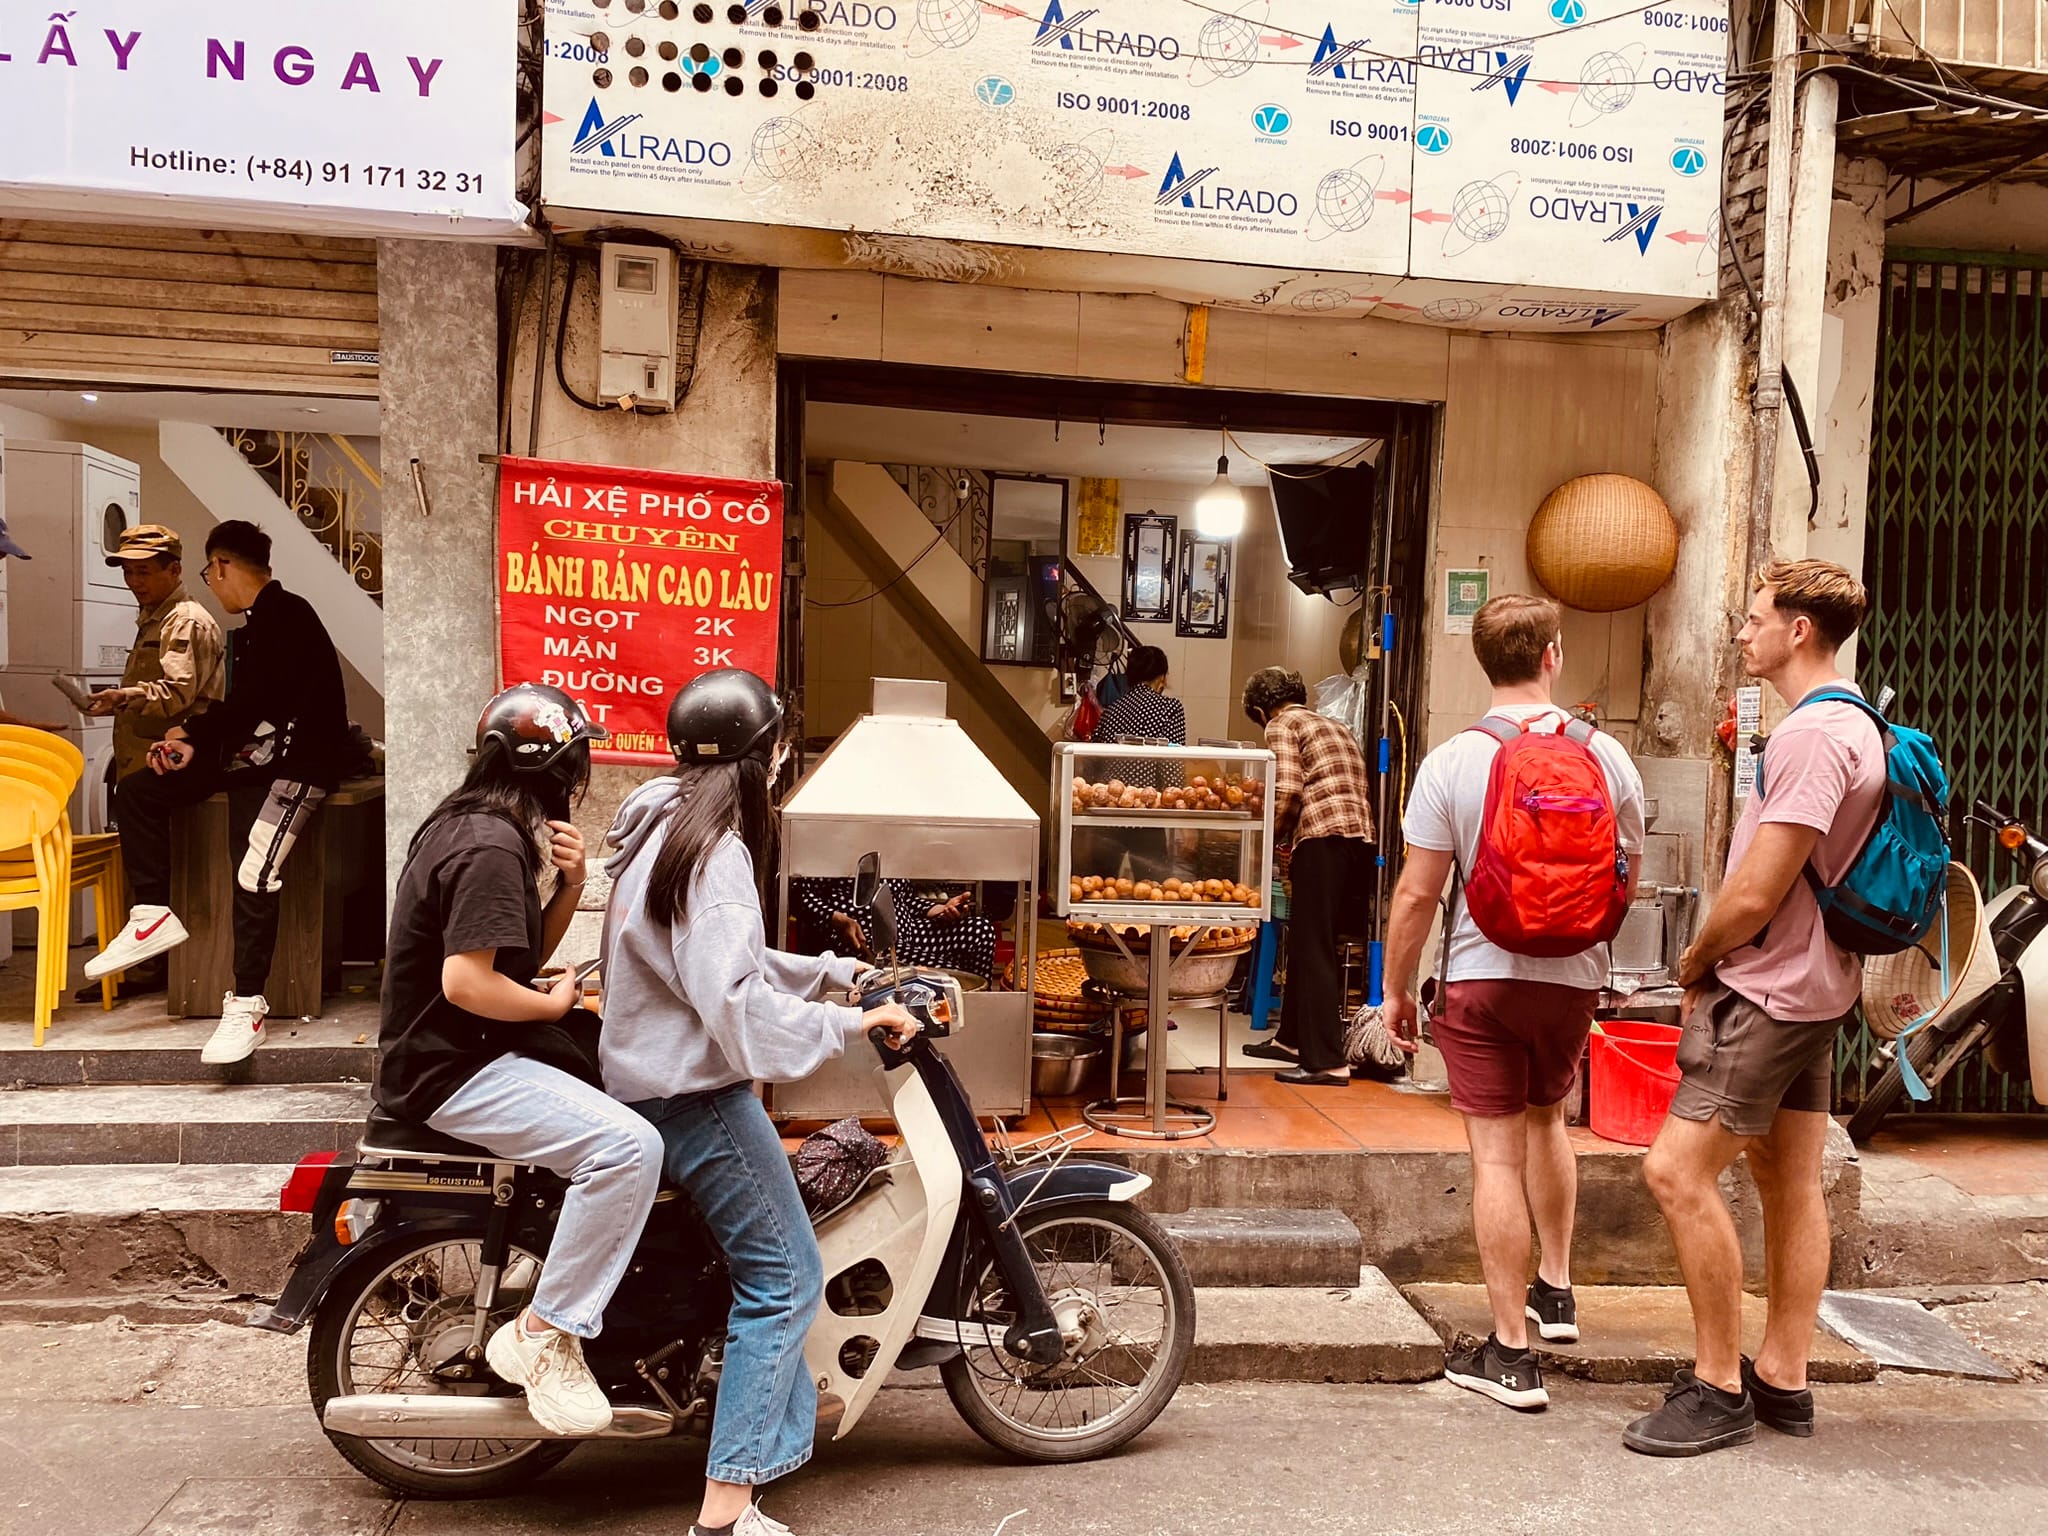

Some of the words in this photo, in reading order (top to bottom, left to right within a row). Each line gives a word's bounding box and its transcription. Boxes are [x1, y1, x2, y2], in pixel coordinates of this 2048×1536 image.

[1032, 0, 1180, 60] ALRADO
[1644, 10, 1728, 33] 9001:2008
[206, 38, 443, 97] NGAY
[810, 68, 908, 92] 9001:2008
[1057, 92, 1090, 110] ISO
[1097, 96, 1190, 120] 9001:2008
[570, 96, 731, 166] ALRADO
[1330, 120, 1362, 137] ISO
[1511, 138, 1597, 160] 9001:2008
[1603, 146, 1633, 163] ISO
[130, 146, 236, 175] Hotline:
[247, 155, 312, 186] (+84)
[323, 162, 350, 183] 91
[364, 165, 405, 188] 171
[417, 170, 446, 191] 32
[456, 174, 482, 194] 31
[570, 166, 598, 174] Remove
[659, 174, 675, 182] days
[694, 178, 731, 186] installation
[656, 165, 686, 173] direction
[688, 168, 703, 176] only
[1155, 150, 1297, 216] ALRADO
[1530, 196, 1664, 257] ALRADO
[1498, 306, 1632, 328] ALRADO
[514, 476, 572, 508] HẢI
[582, 486, 628, 518] XỆ
[640, 490, 712, 520] PHỐ
[722, 493, 771, 525] CỔ
[544, 519, 739, 552] CHUYÊN
[506, 541, 584, 598] BÁNH
[591, 549, 651, 603] RÁN
[657, 564, 713, 608] CAO
[719, 559, 773, 612] LÂU
[545, 605, 640, 633] NGỌT
[694, 616, 736, 637] 2K
[544, 635, 616, 662] MẶN
[693, 646, 734, 666] 3K
[541, 667, 664, 696] ĐƯỜNG
[440, 1178, 484, 1186] CUSTOM
